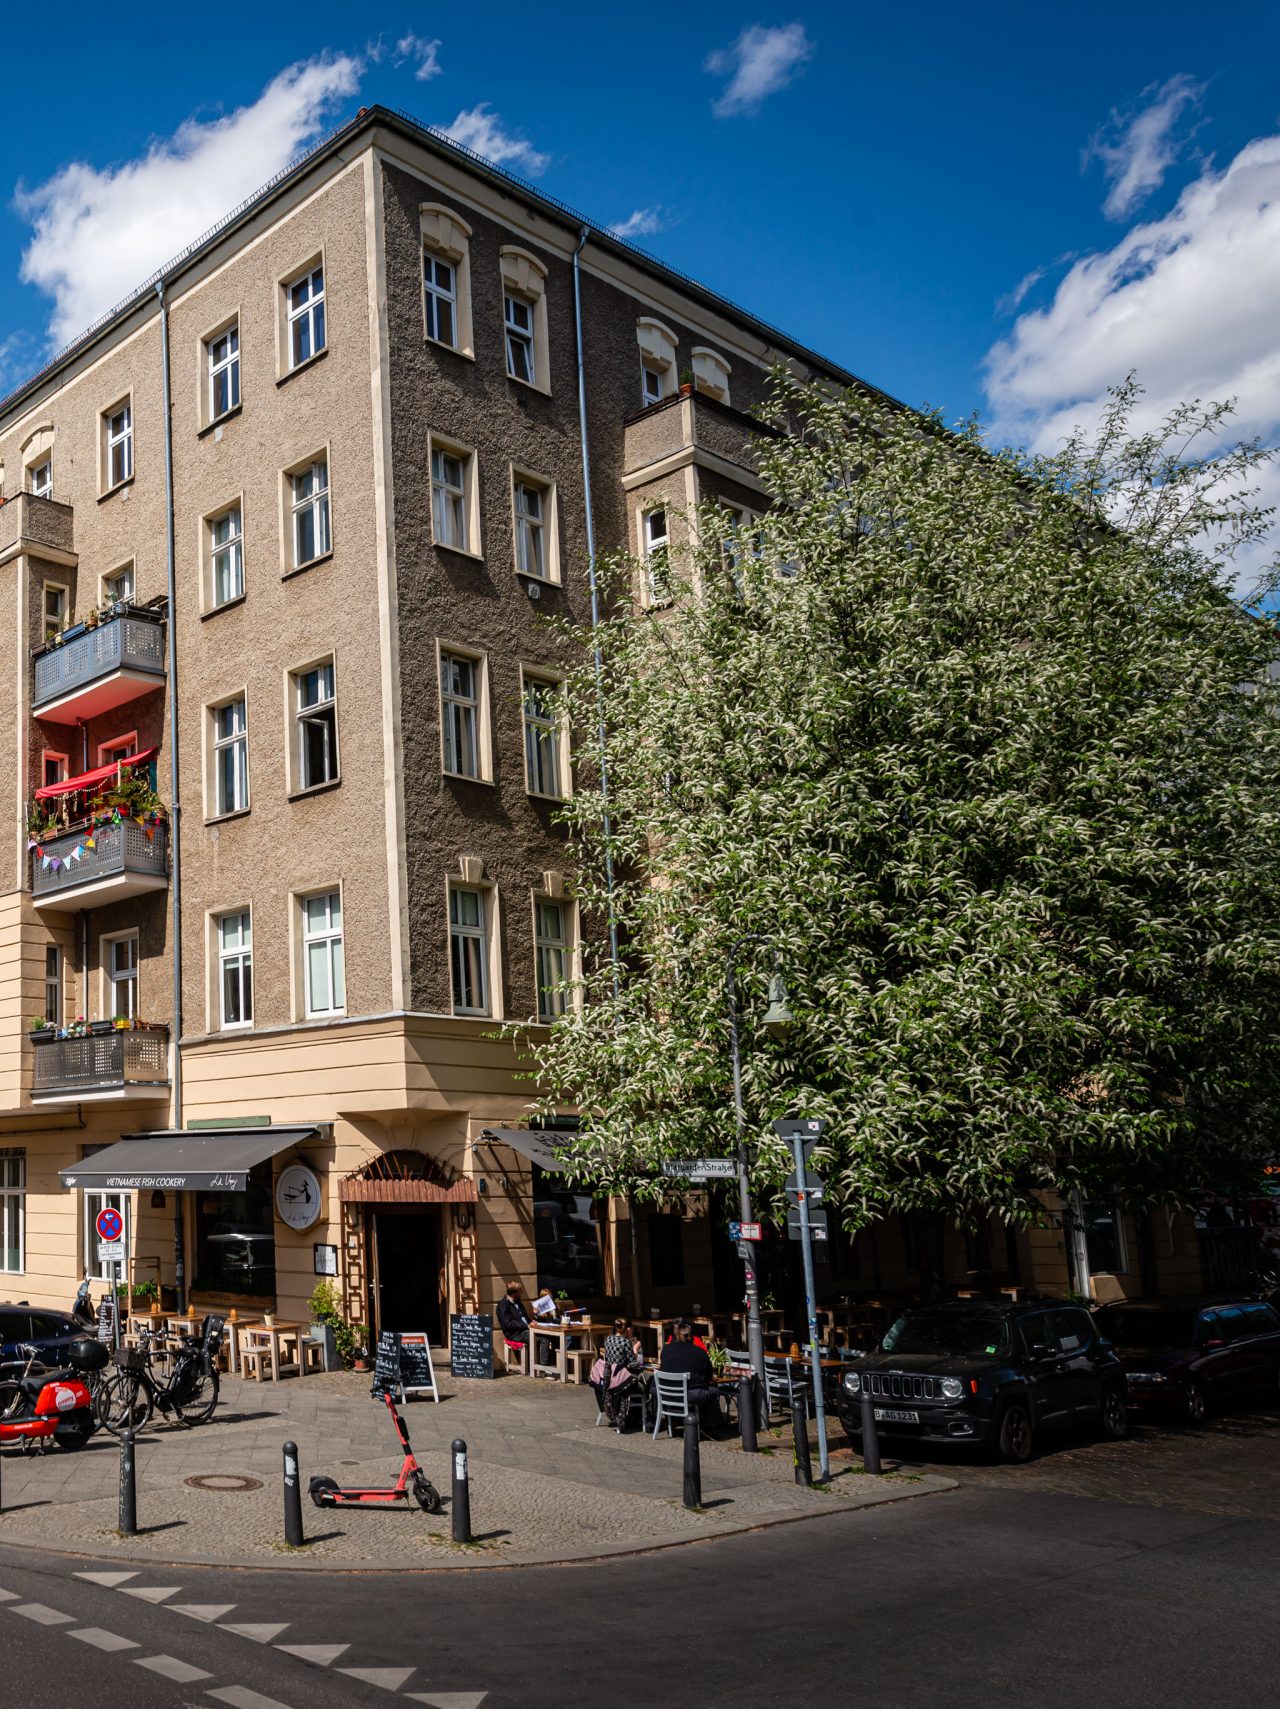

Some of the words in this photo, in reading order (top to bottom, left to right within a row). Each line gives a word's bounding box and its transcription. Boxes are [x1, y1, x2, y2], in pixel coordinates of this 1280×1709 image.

[706, 1163, 732, 1173] Straße
[106, 1177, 141, 1187] VIETNAMESE
[142, 1177, 155, 1187] FISH
[155, 1177, 186, 1187] COOKERY
